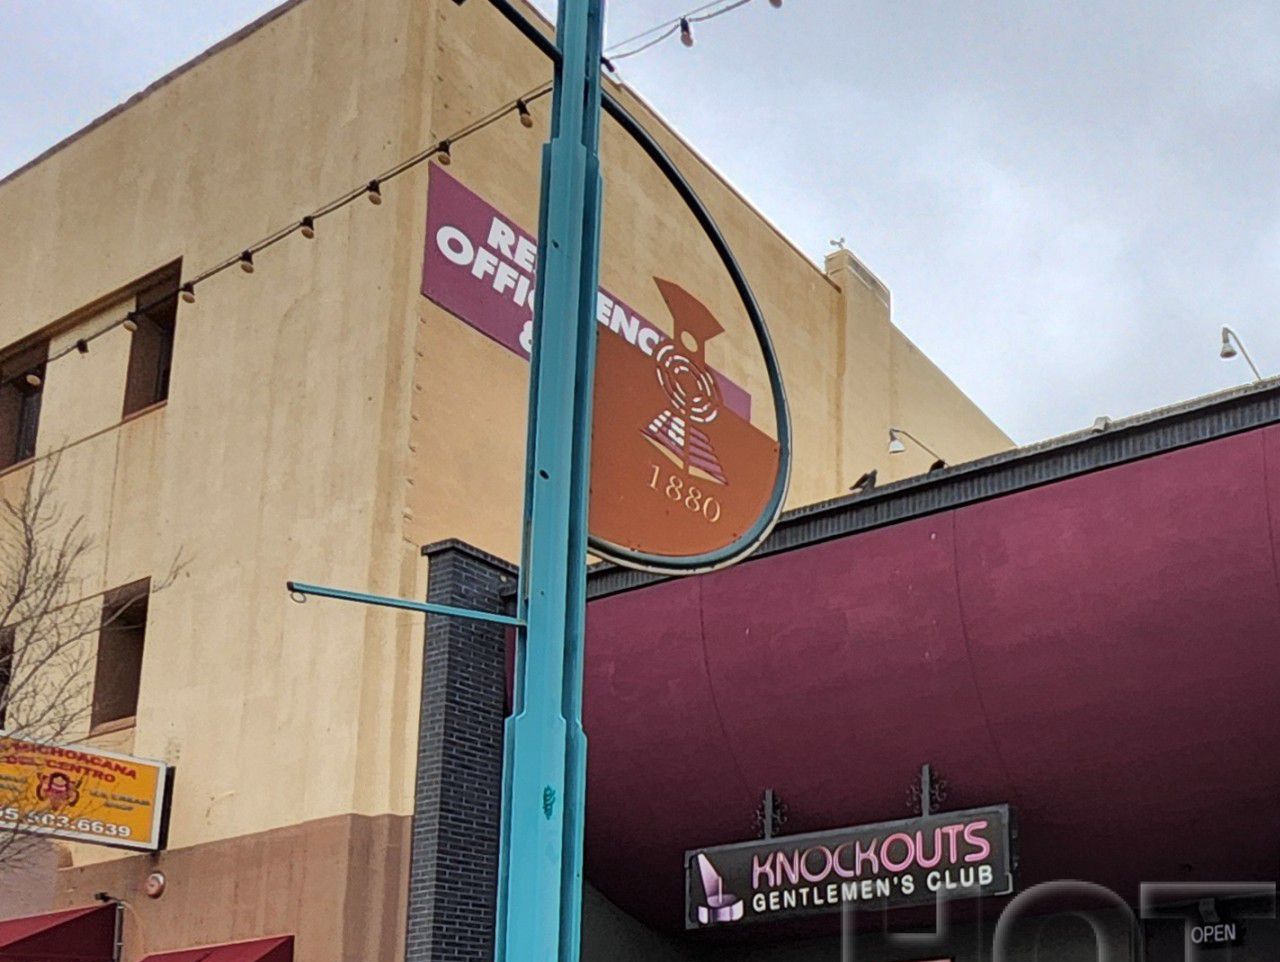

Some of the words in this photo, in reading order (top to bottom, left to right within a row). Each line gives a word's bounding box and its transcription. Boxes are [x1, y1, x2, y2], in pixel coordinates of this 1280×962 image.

[436, 226, 536, 314] OFFI
[648, 465, 722, 523] 1880
[46, 760, 116, 783] CENTRO
[752, 820, 991, 889] KNOCKOUTS
[752, 873, 915, 912] GENTLEMEN'S
[926, 865, 993, 891] CLUB
[1191, 923, 1236, 943] OPEN
